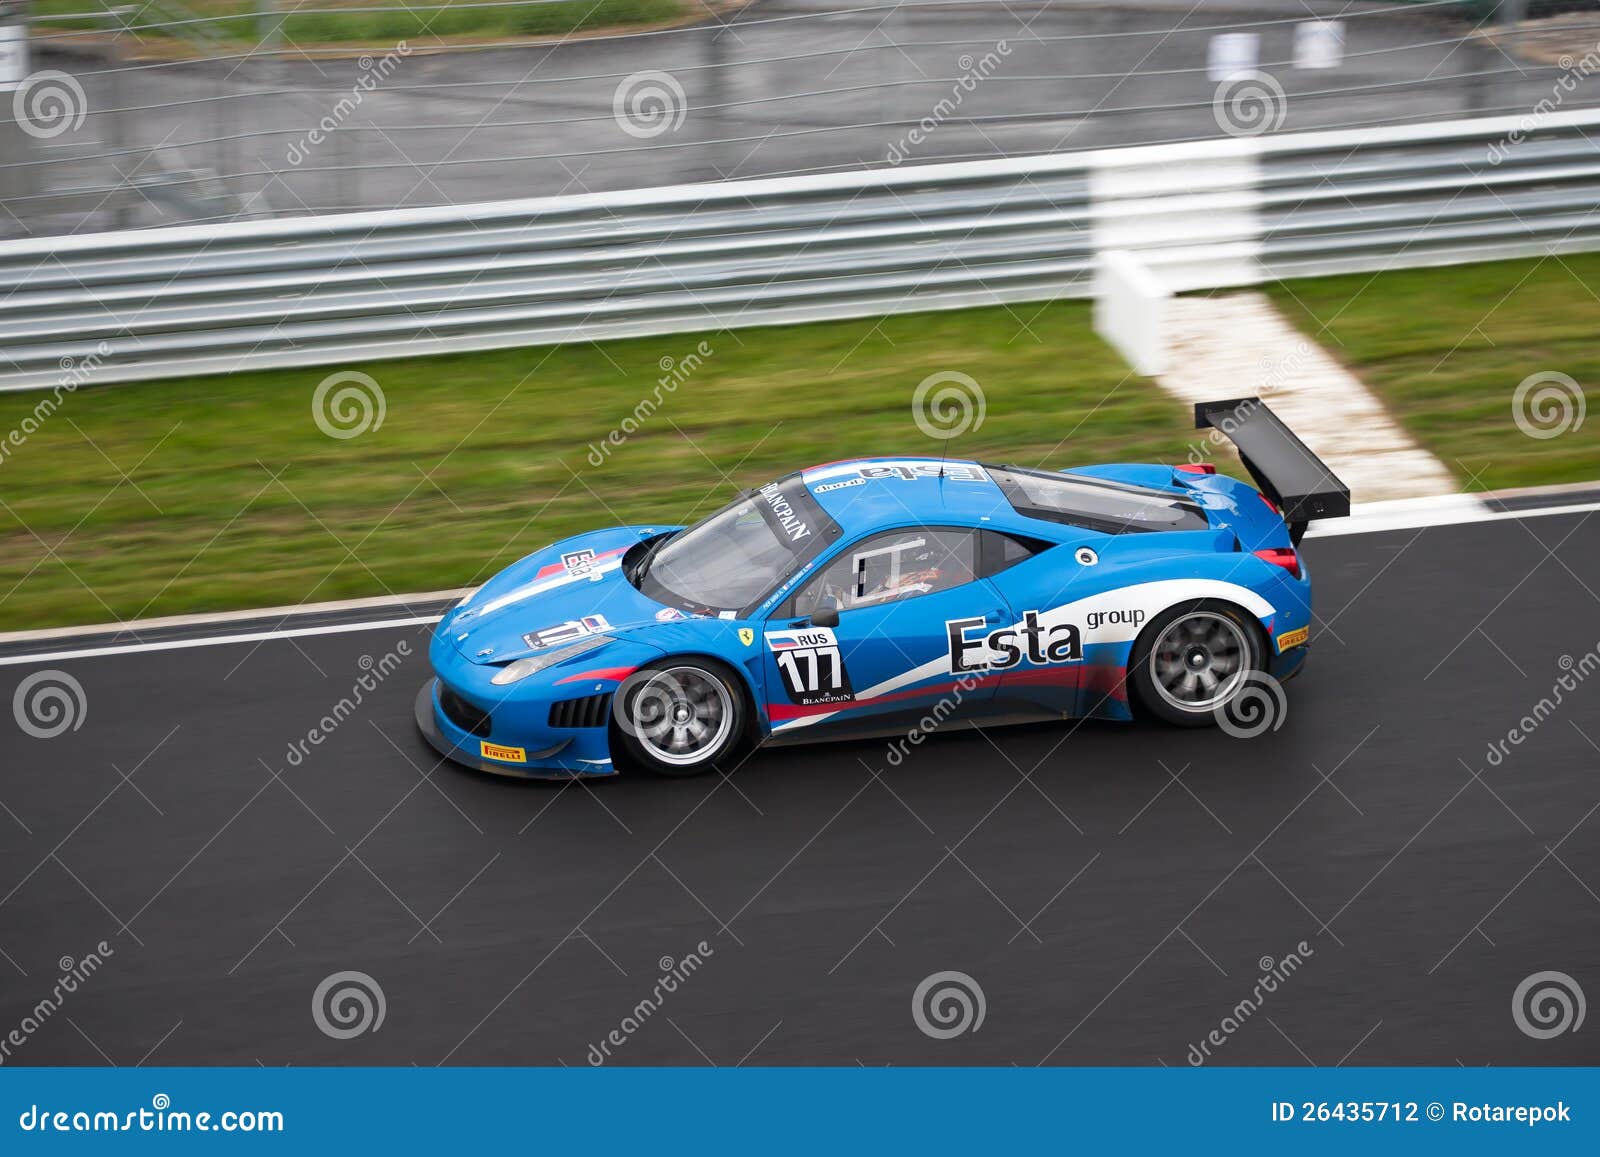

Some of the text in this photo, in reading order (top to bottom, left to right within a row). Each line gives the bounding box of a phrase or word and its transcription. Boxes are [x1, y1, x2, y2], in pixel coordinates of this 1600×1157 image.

[797, 633, 828, 646] RUS
[947, 609, 1145, 674] Esta group
[777, 646, 842, 692] 177
[802, 694, 851, 705] BLANCPAIN
